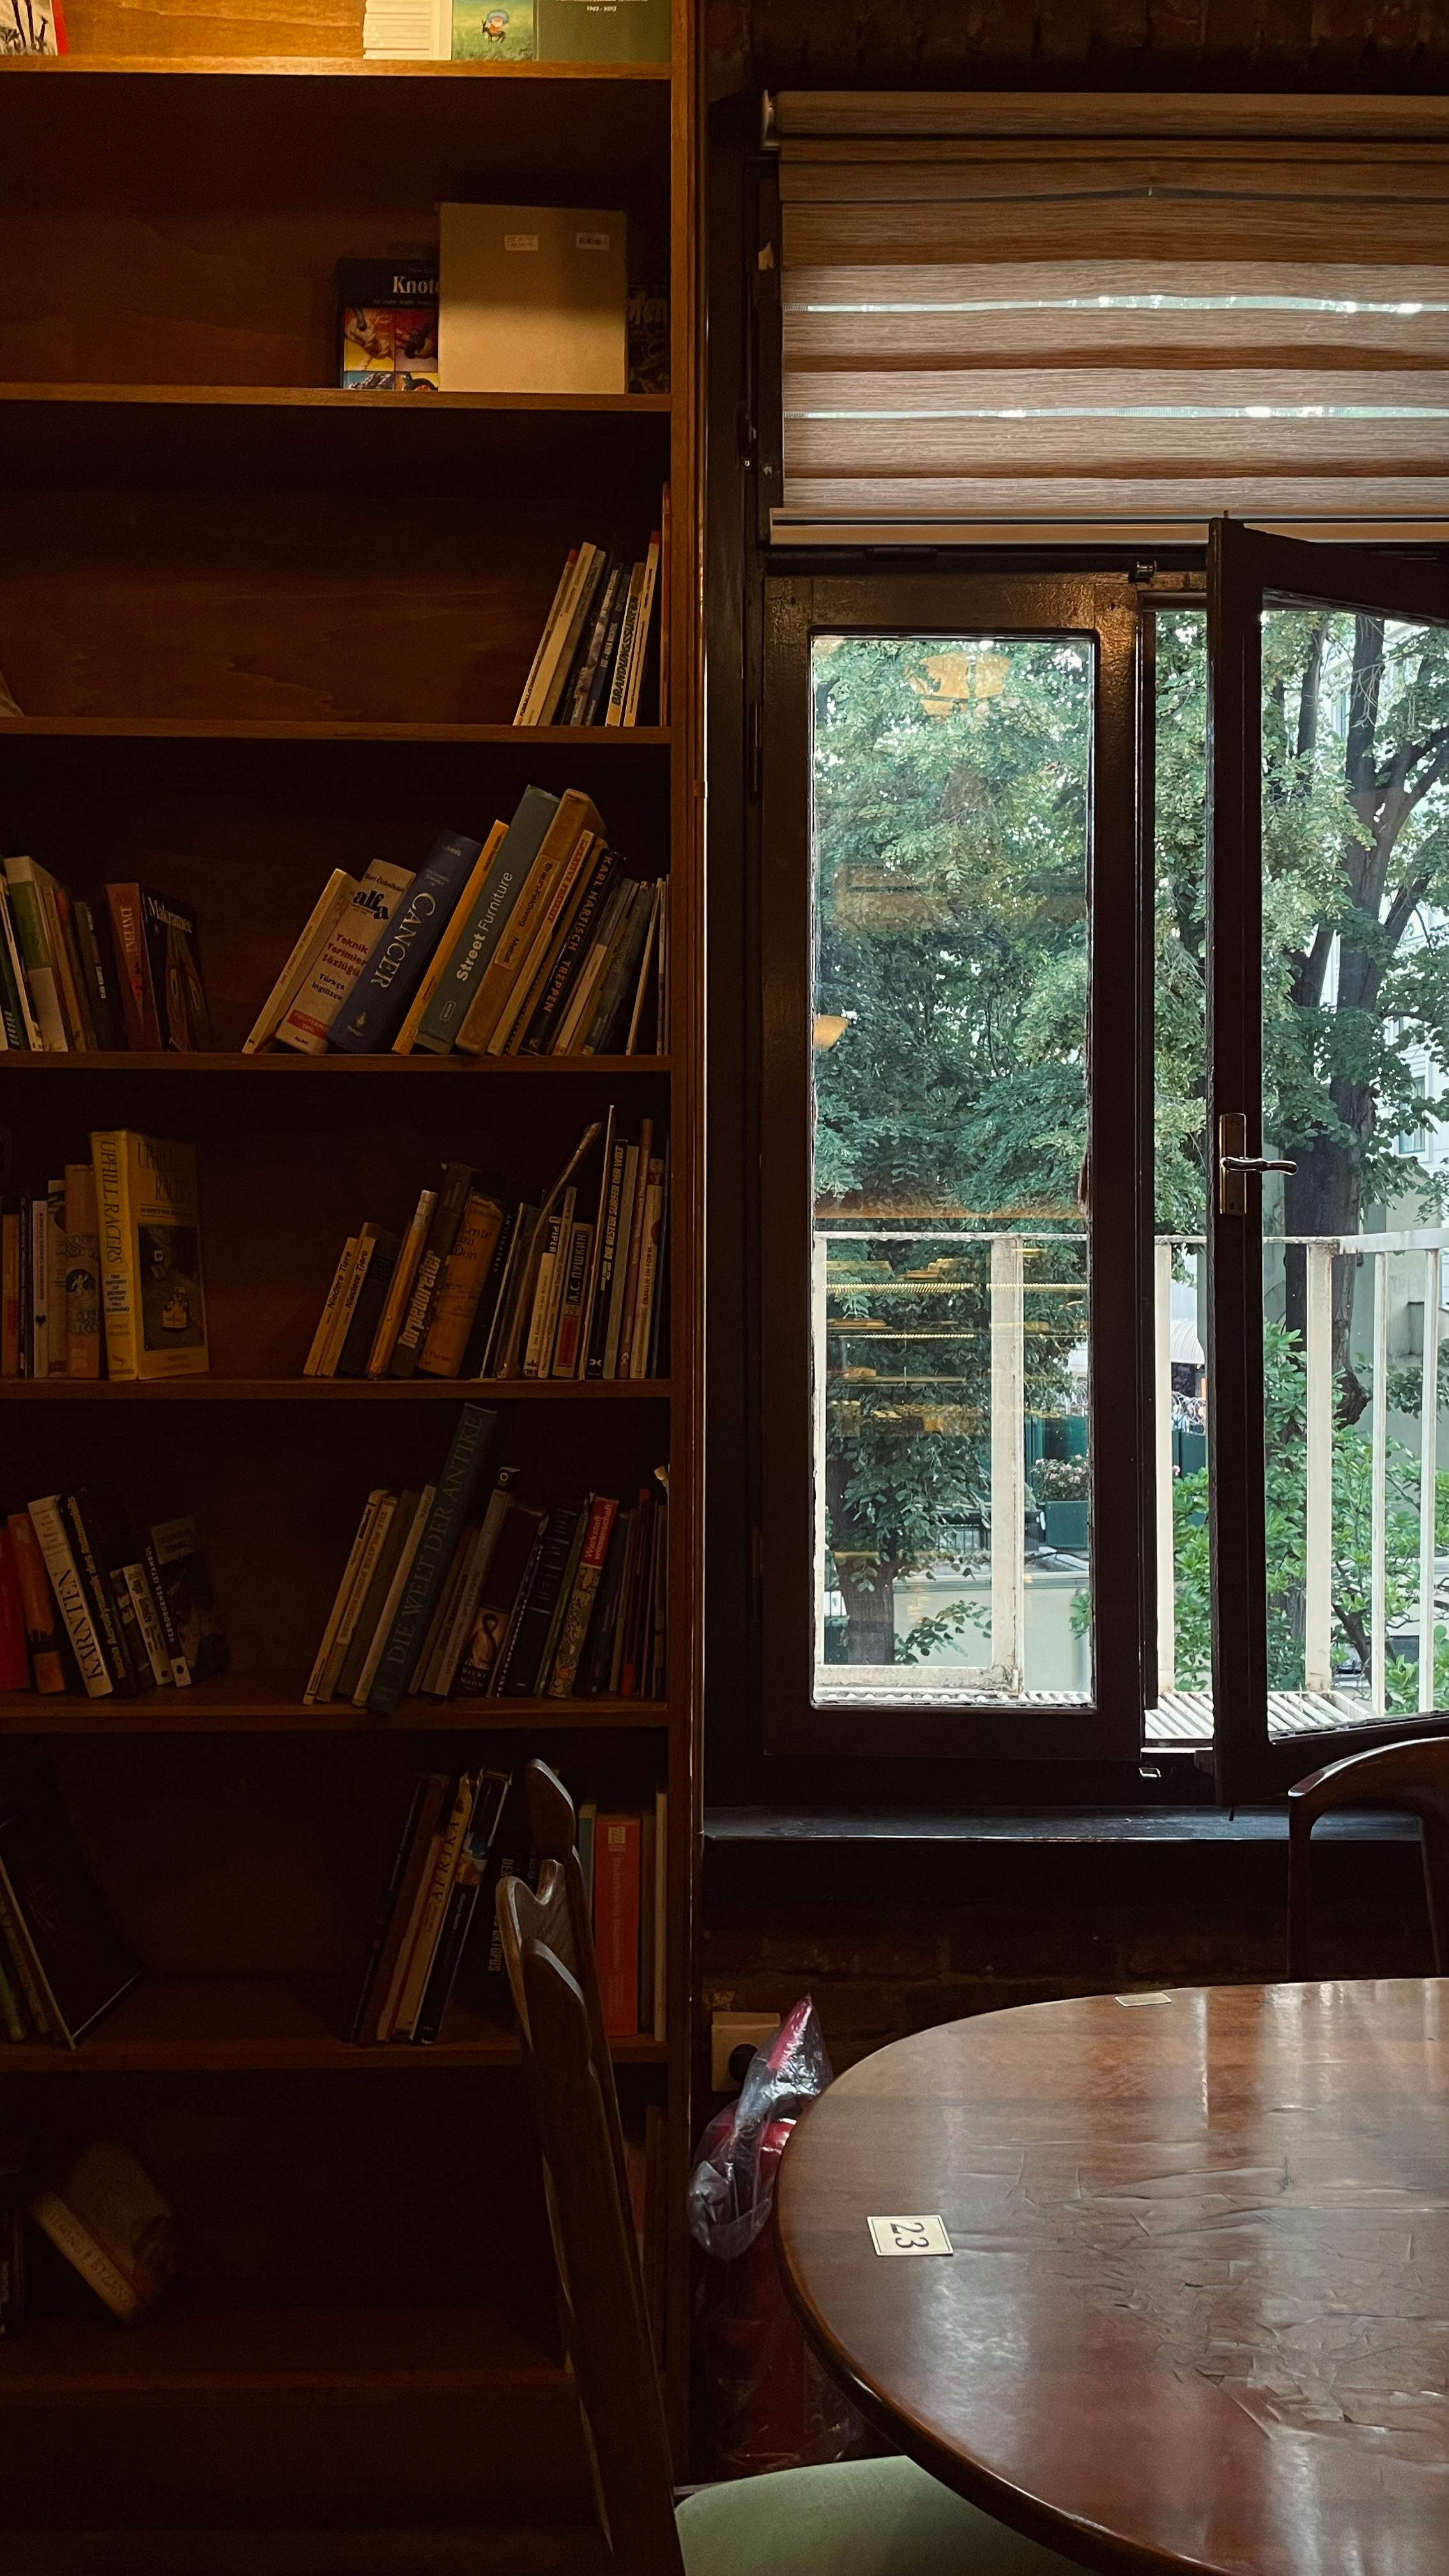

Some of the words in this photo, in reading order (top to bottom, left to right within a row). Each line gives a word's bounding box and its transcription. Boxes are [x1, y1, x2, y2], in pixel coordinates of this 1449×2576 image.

[611, 595, 638, 706] BRANDUNGSSURFEN
[595, 855, 613, 896] KARL
[337, 934, 369, 954] Teknik
[370, 892, 437, 989] CANCER
[456, 932, 486, 982] Street
[478, 871, 513, 932] Furniture
[567, 896, 599, 952] HARTISCH
[321, 954, 360, 977] Sözlüğü
[327, 943, 369, 967] Terimler
[319, 974, 345, 990] Türkçe
[542, 960, 572, 1013] TREPPEN
[100, 1140, 119, 1199] UPHILL
[611, 1167, 621, 1184] DER
[613, 1146, 624, 1167] WELT
[608, 1185, 620, 1215] SURFER
[103, 1202, 123, 1264] RACERS
[549, 1224, 560, 1254] PIPER
[605, 1215, 617, 1246] BESTEN
[454, 1243, 477, 1261] Don
[571, 1232, 588, 1276] ПУШКИН
[604, 1245, 614, 1261] DIE
[328, 1276, 344, 1308] Niedere
[339, 1250, 353, 1273] Tiere
[345, 1276, 362, 1309] Niedere
[356, 1250, 369, 1272] Tiere
[397, 1249, 442, 1349] Torpedoreiter
[567, 1277, 579, 1303] А.С.
[362, 1529, 382, 1570] PILATES
[386, 1627, 409, 1664] DIE
[404, 1554, 436, 1617] WELT
[426, 1506, 453, 1549] DER
[442, 1416, 482, 1505] ANTIKE
[595, 1503, 613, 1560] wissenschaft
[145, 1544, 162, 1584] ISTANBUL
[156, 1584, 175, 1643] VERBORGENES
[431, 1820, 460, 1903] AFRIKA
[890, 2222, 929, 2250] 23
